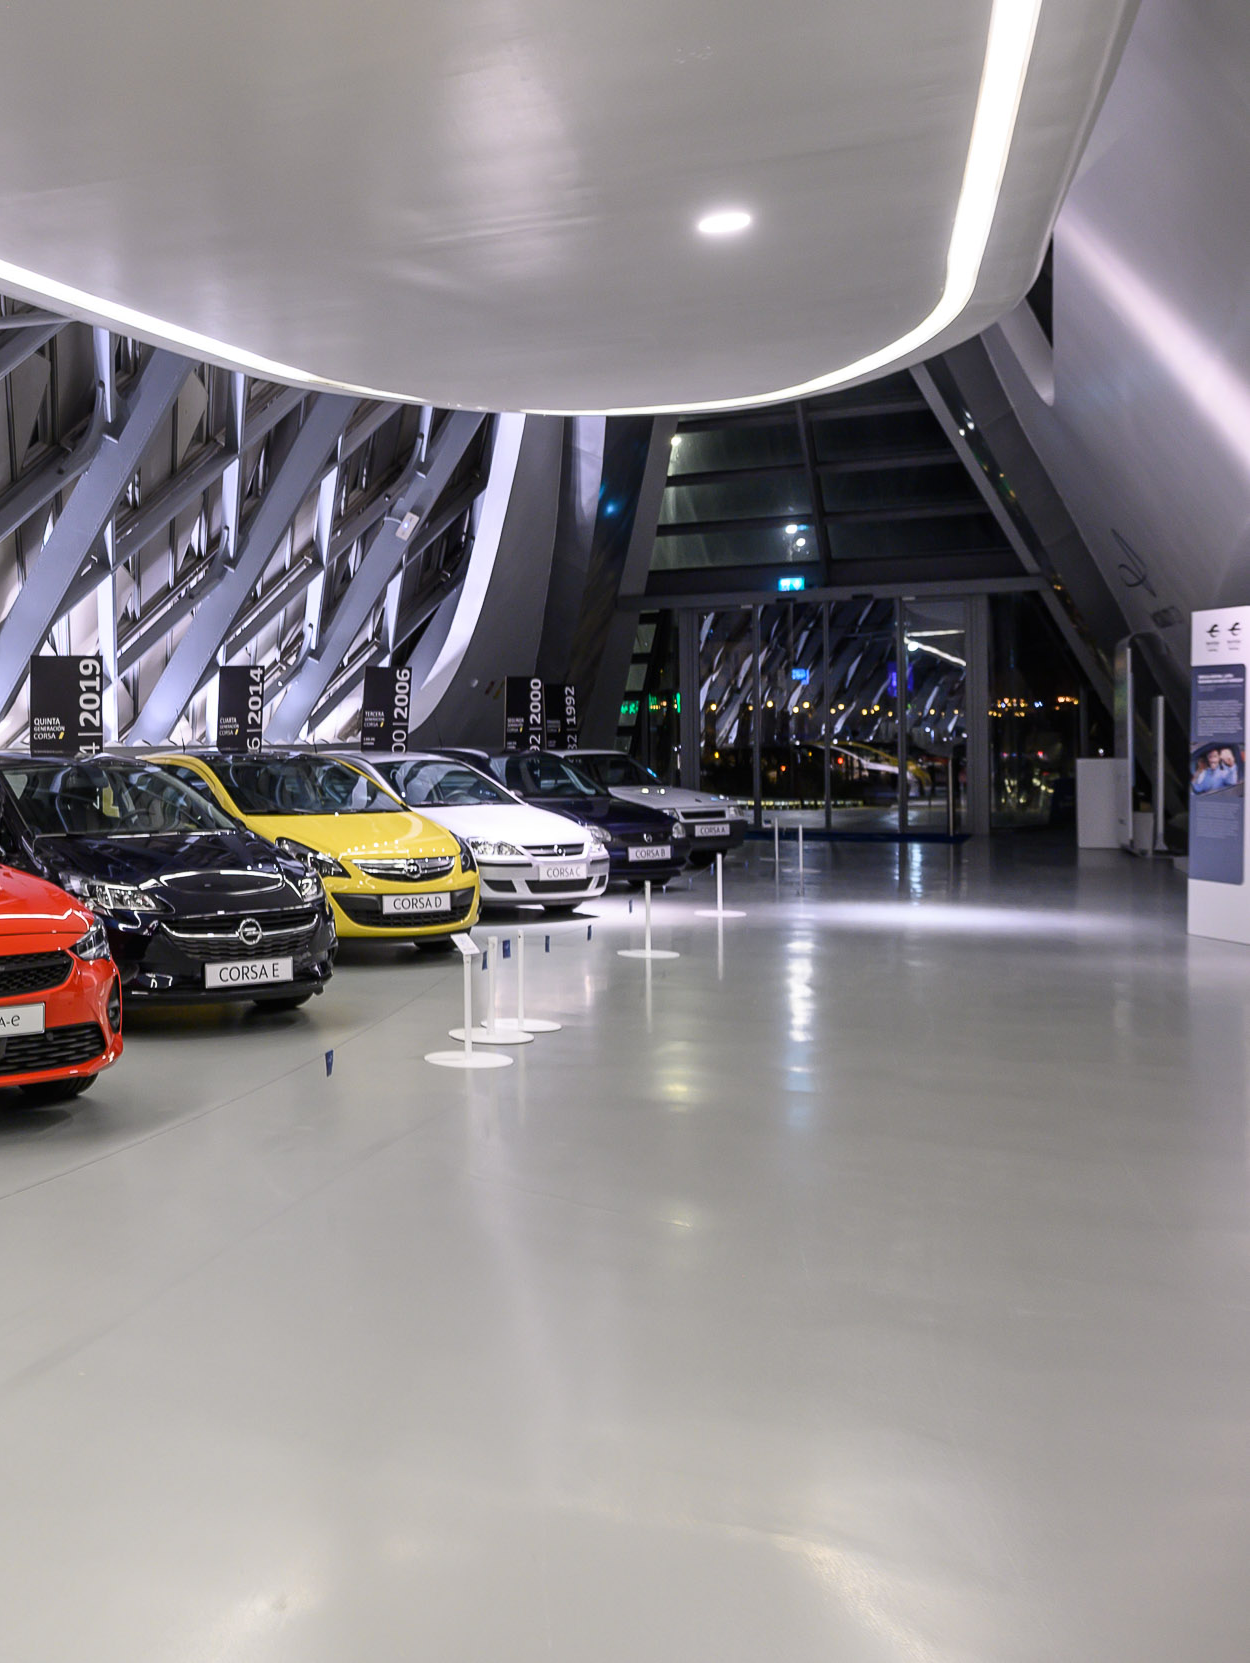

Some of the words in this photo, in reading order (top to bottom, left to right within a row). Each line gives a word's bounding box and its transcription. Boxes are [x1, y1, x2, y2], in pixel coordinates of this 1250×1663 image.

[79, 658, 101, 727] 2019
[247, 667, 263, 725] 2014
[393, 668, 411, 720] 2006
[529, 678, 542, 725] 2000
[564, 685, 576, 725] 1992
[33, 717, 61, 726] QUINTA
[33, 732, 57, 740] CORSA
[700, 826, 721, 835] CORSA
[635, 848, 659, 859] CORSA
[546, 866, 575, 878] CORSA
[576, 866, 581, 877] C
[393, 897, 433, 910] CORSA
[434, 895, 442, 908] D
[219, 964, 268, 982] CORSA
[272, 962, 280, 978] E
